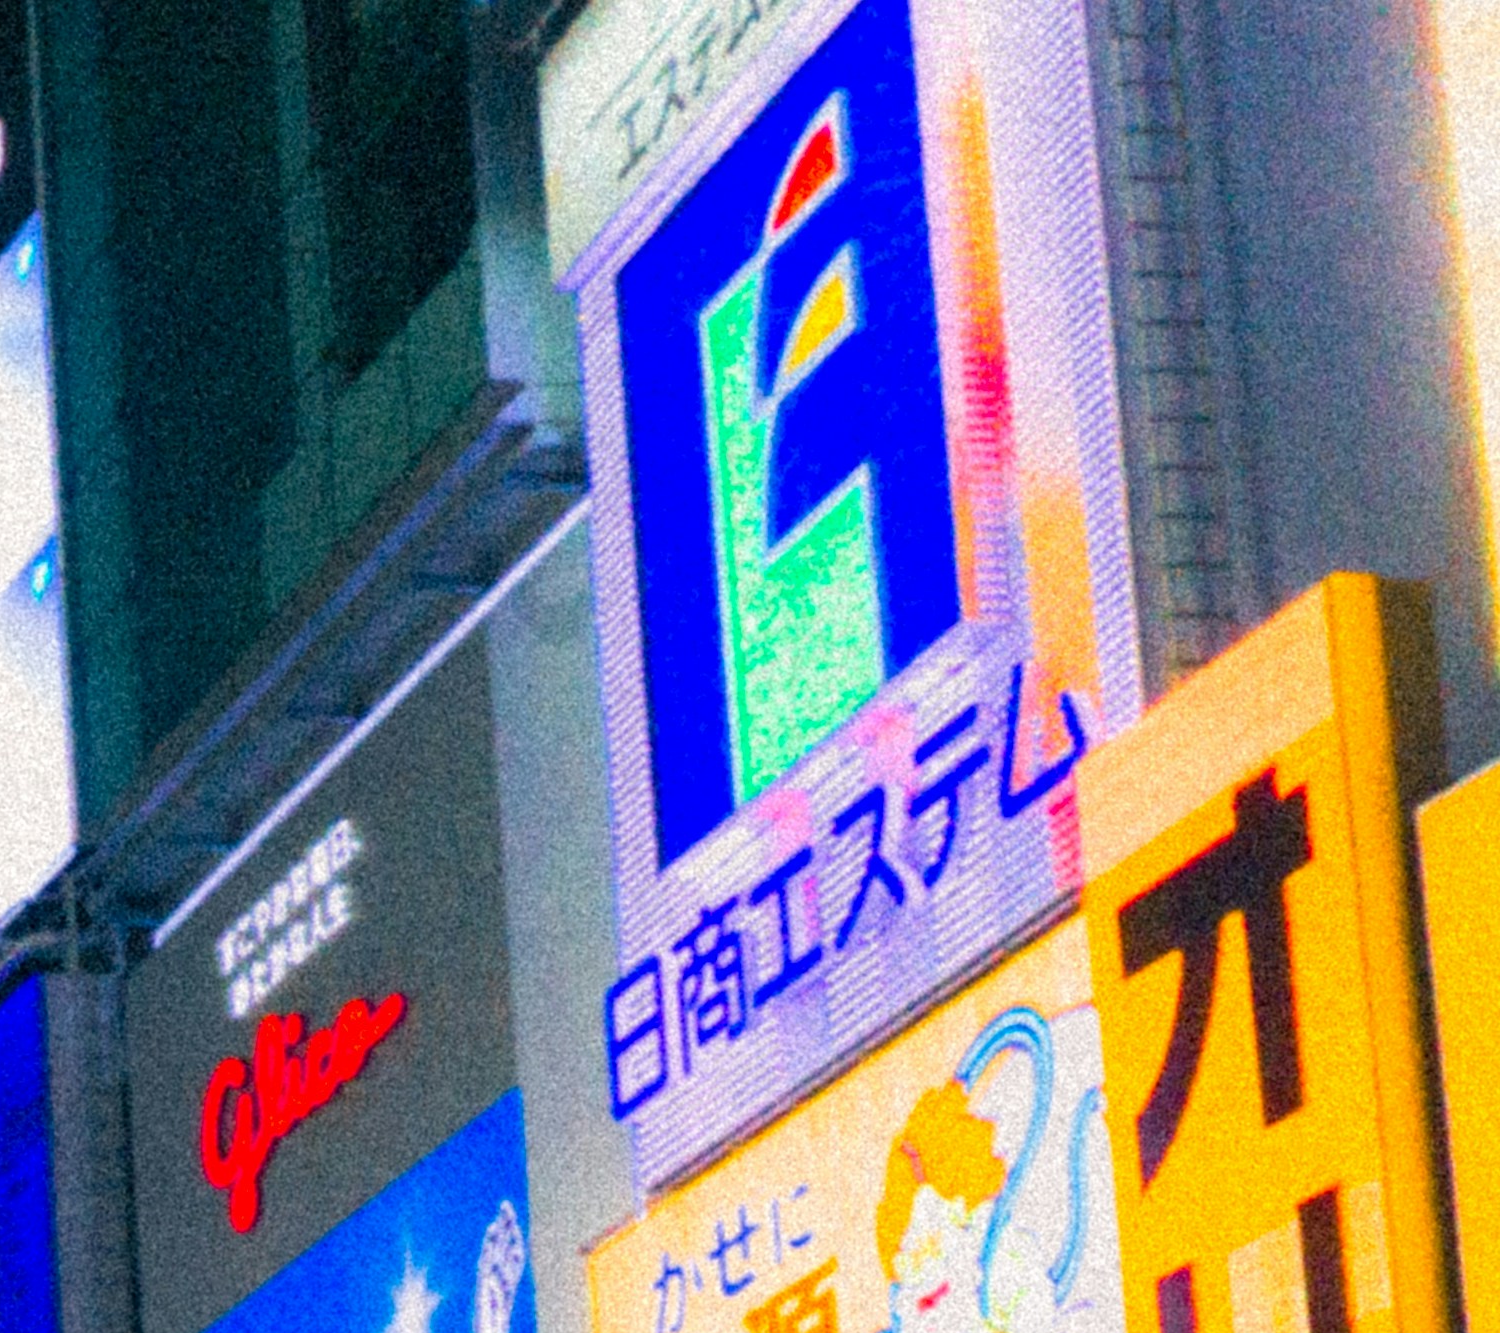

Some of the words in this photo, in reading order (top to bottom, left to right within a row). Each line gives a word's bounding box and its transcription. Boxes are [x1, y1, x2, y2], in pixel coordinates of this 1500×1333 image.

[605, 660, 1086, 1121] 日商エステム
[202, 993, 407, 1234] Glico
